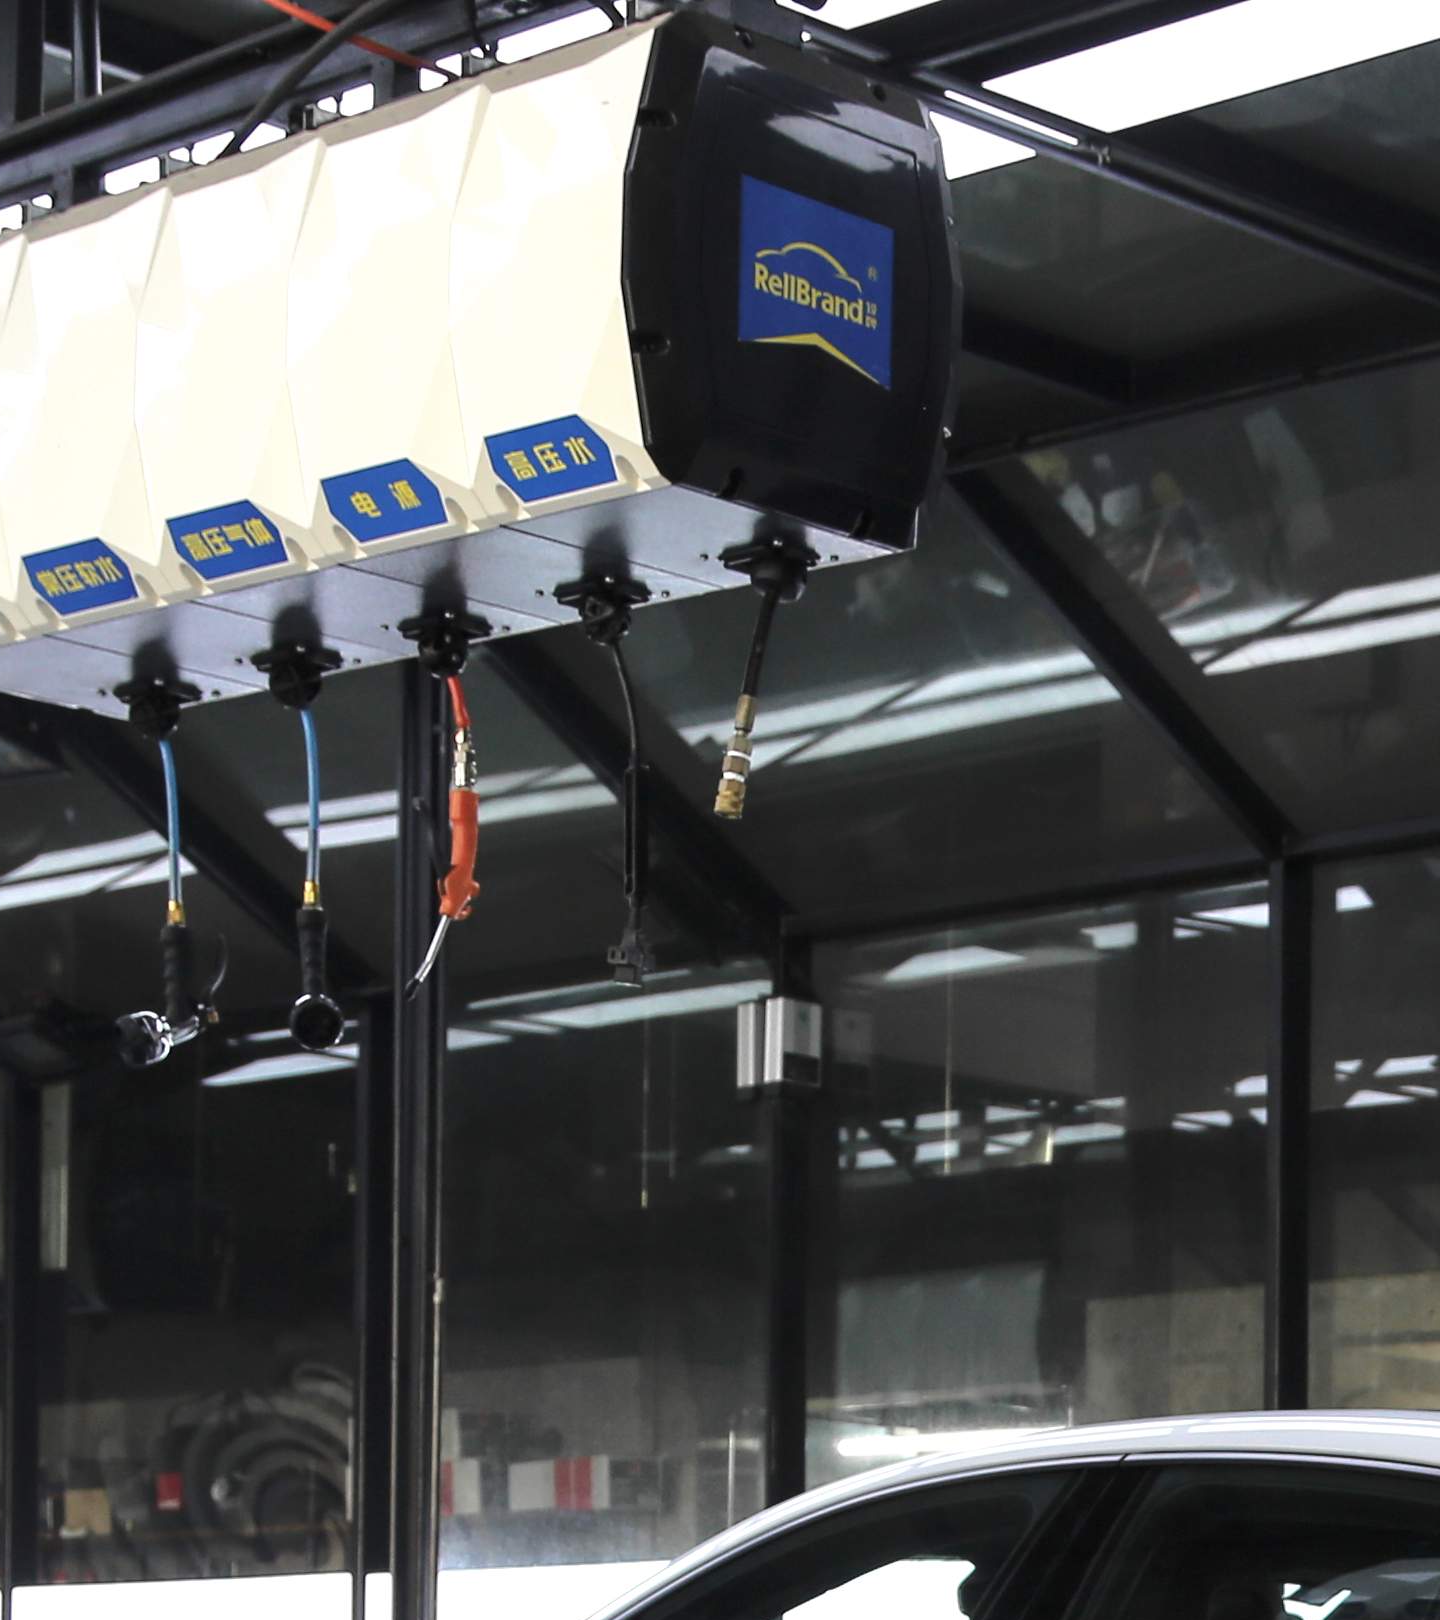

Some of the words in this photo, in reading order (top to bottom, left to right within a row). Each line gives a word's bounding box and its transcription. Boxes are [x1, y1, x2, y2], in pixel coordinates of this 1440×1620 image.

[754, 262, 864, 325] RellBrand
[503, 435, 598, 481] 高压水
